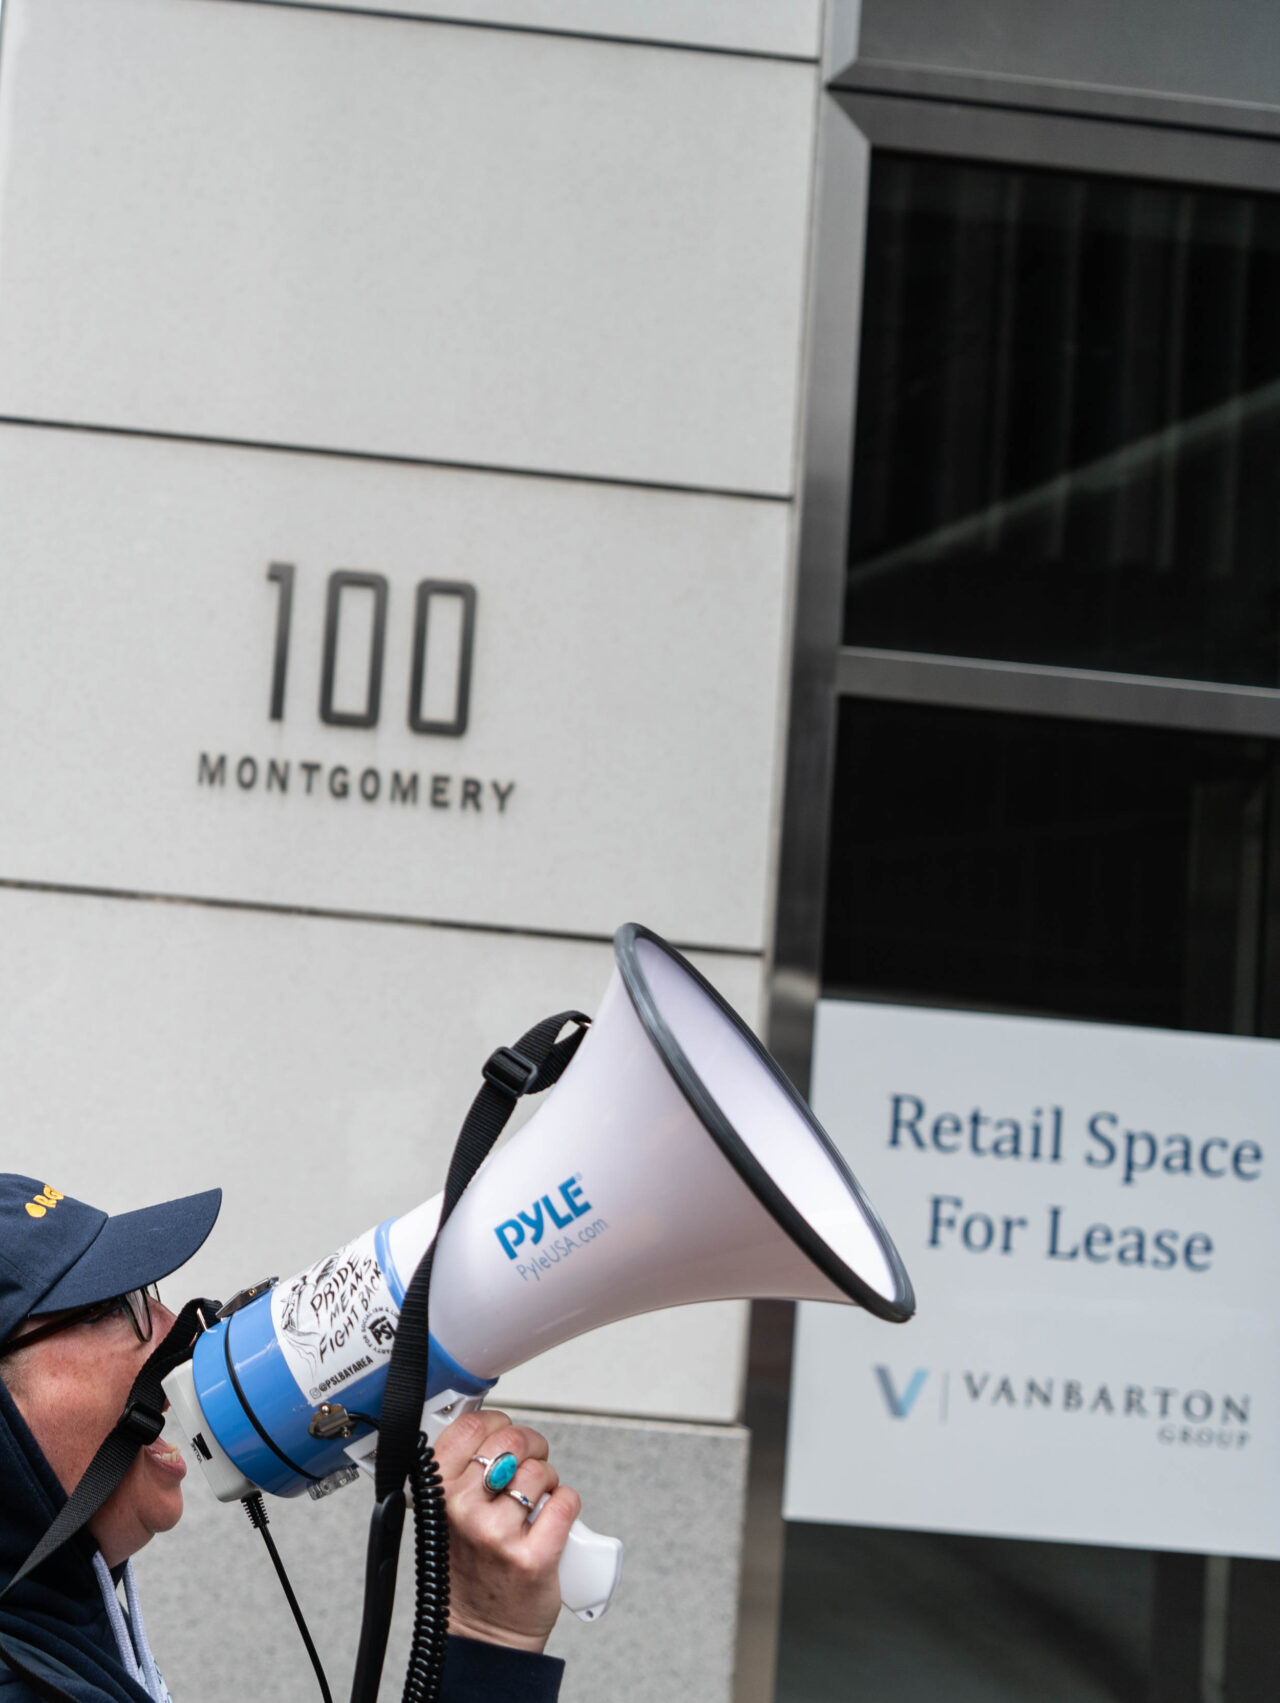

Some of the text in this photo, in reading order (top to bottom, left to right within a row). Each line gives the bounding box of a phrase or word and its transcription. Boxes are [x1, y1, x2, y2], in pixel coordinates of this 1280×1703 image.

[266, 561, 477, 738] 100
[198, 752, 518, 814] MONTGOMERY
[886, 1092, 1265, 1186] Retail Space
[494, 1176, 592, 1261] PYLE
[516, 1218, 609, 1281] PyleUSA.com
[927, 1195, 1214, 1274] For Lease
[310, 1254, 360, 1325] PRIDE
[320, 1261, 382, 1364] FIGHT BACK
[330, 1258, 372, 1328] MEANS
[320, 1355, 374, 1392] @PSLBAYAREA
[963, 1368, 1252, 1426] VANBARTON
[1158, 1425, 1252, 1449] GROUP
